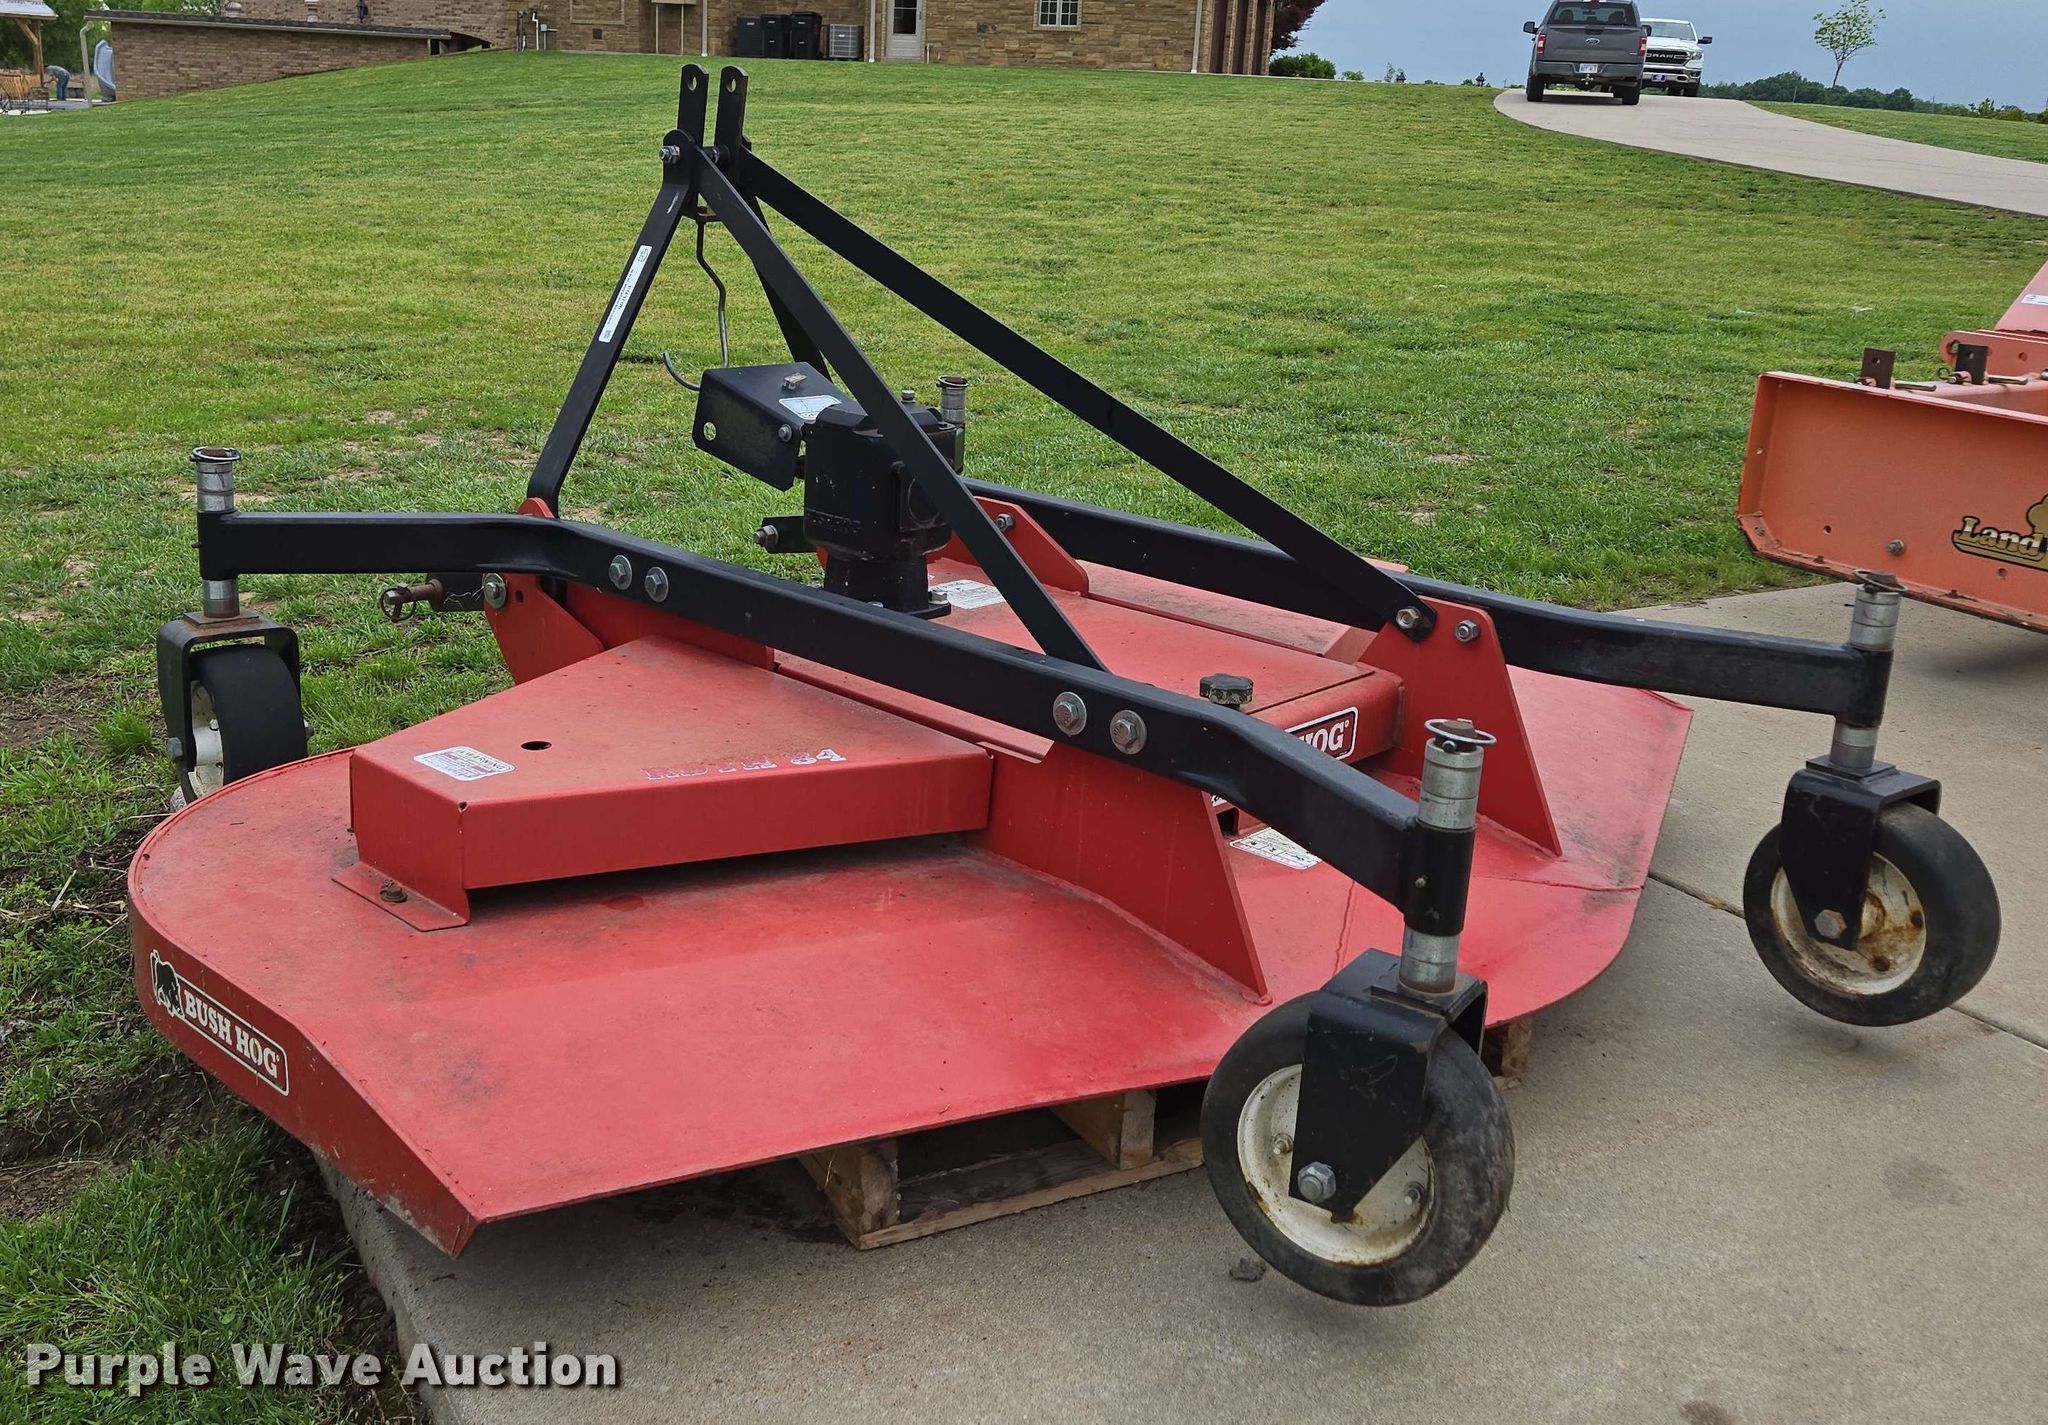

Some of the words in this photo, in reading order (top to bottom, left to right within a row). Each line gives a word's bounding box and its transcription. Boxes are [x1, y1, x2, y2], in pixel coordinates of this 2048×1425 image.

[1957, 515, 2044, 557] Land
[183, 989, 233, 1045] BUSH
[235, 1025, 279, 1079] HOG
